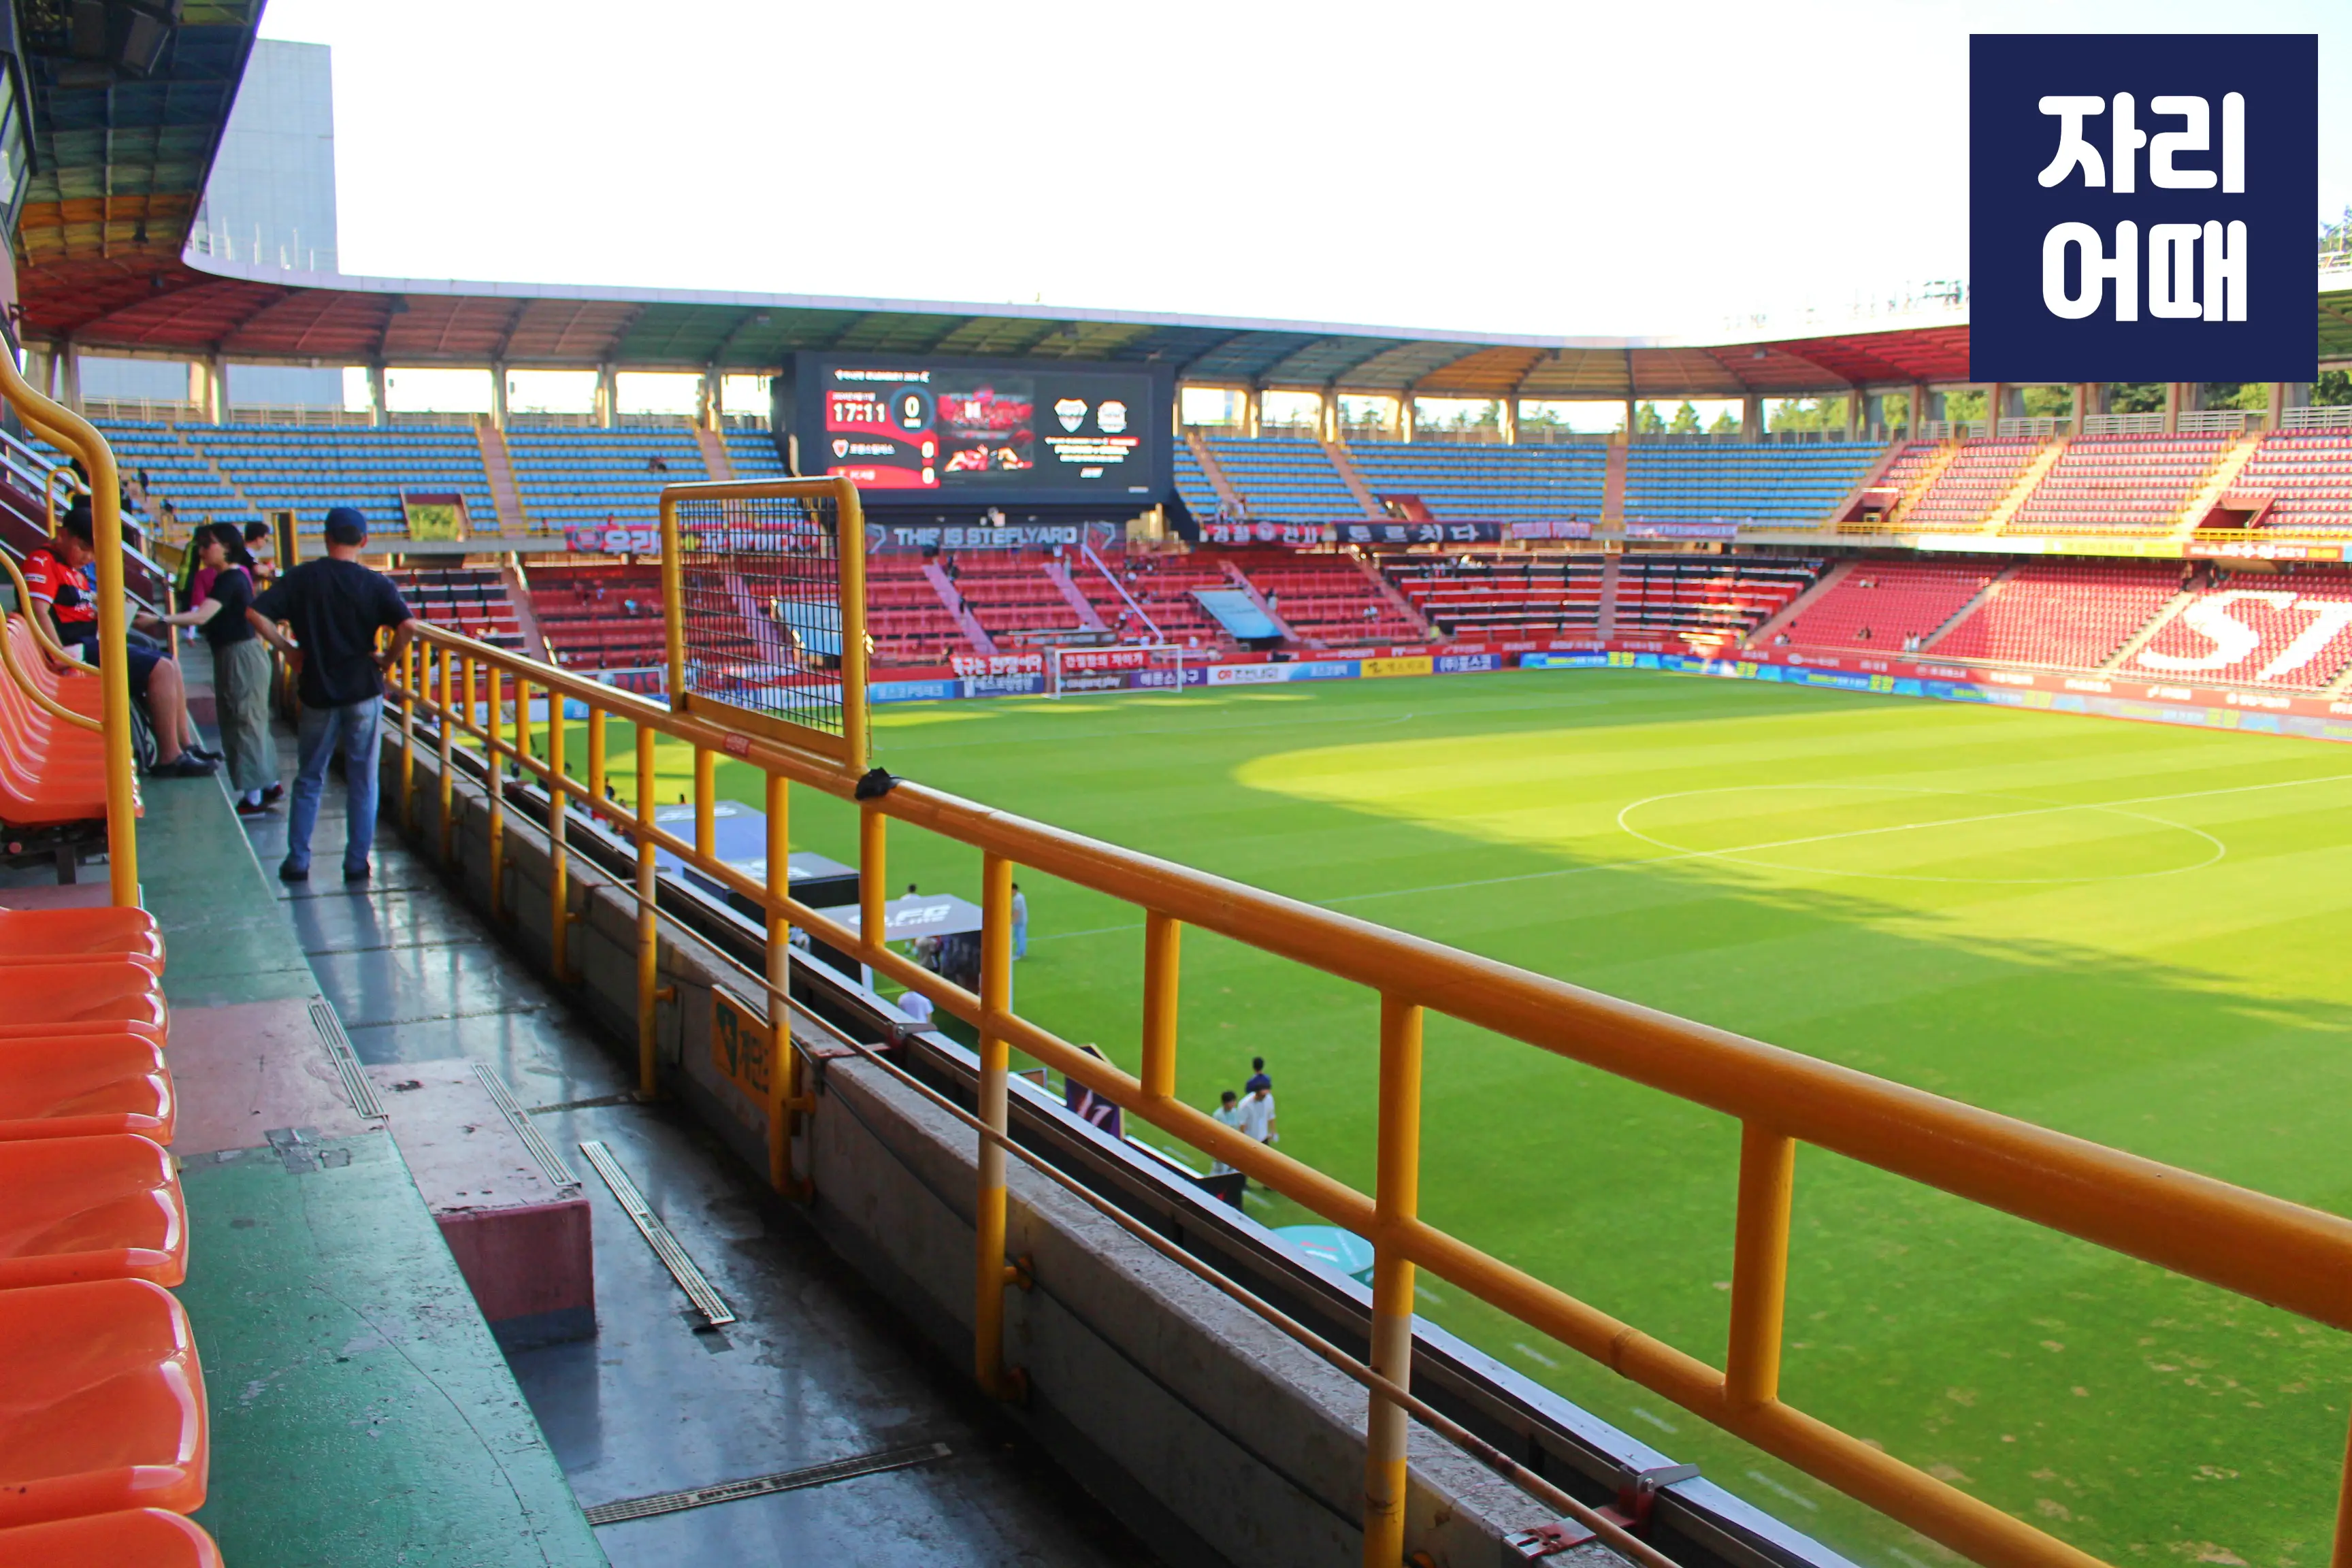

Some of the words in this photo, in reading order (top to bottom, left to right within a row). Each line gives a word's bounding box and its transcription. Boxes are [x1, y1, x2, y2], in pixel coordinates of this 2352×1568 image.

[834, 402, 885, 423] 17:11
[904, 395, 919, 418] 0
[921, 441, 934, 458] 0
[922, 467, 934, 484] 0
